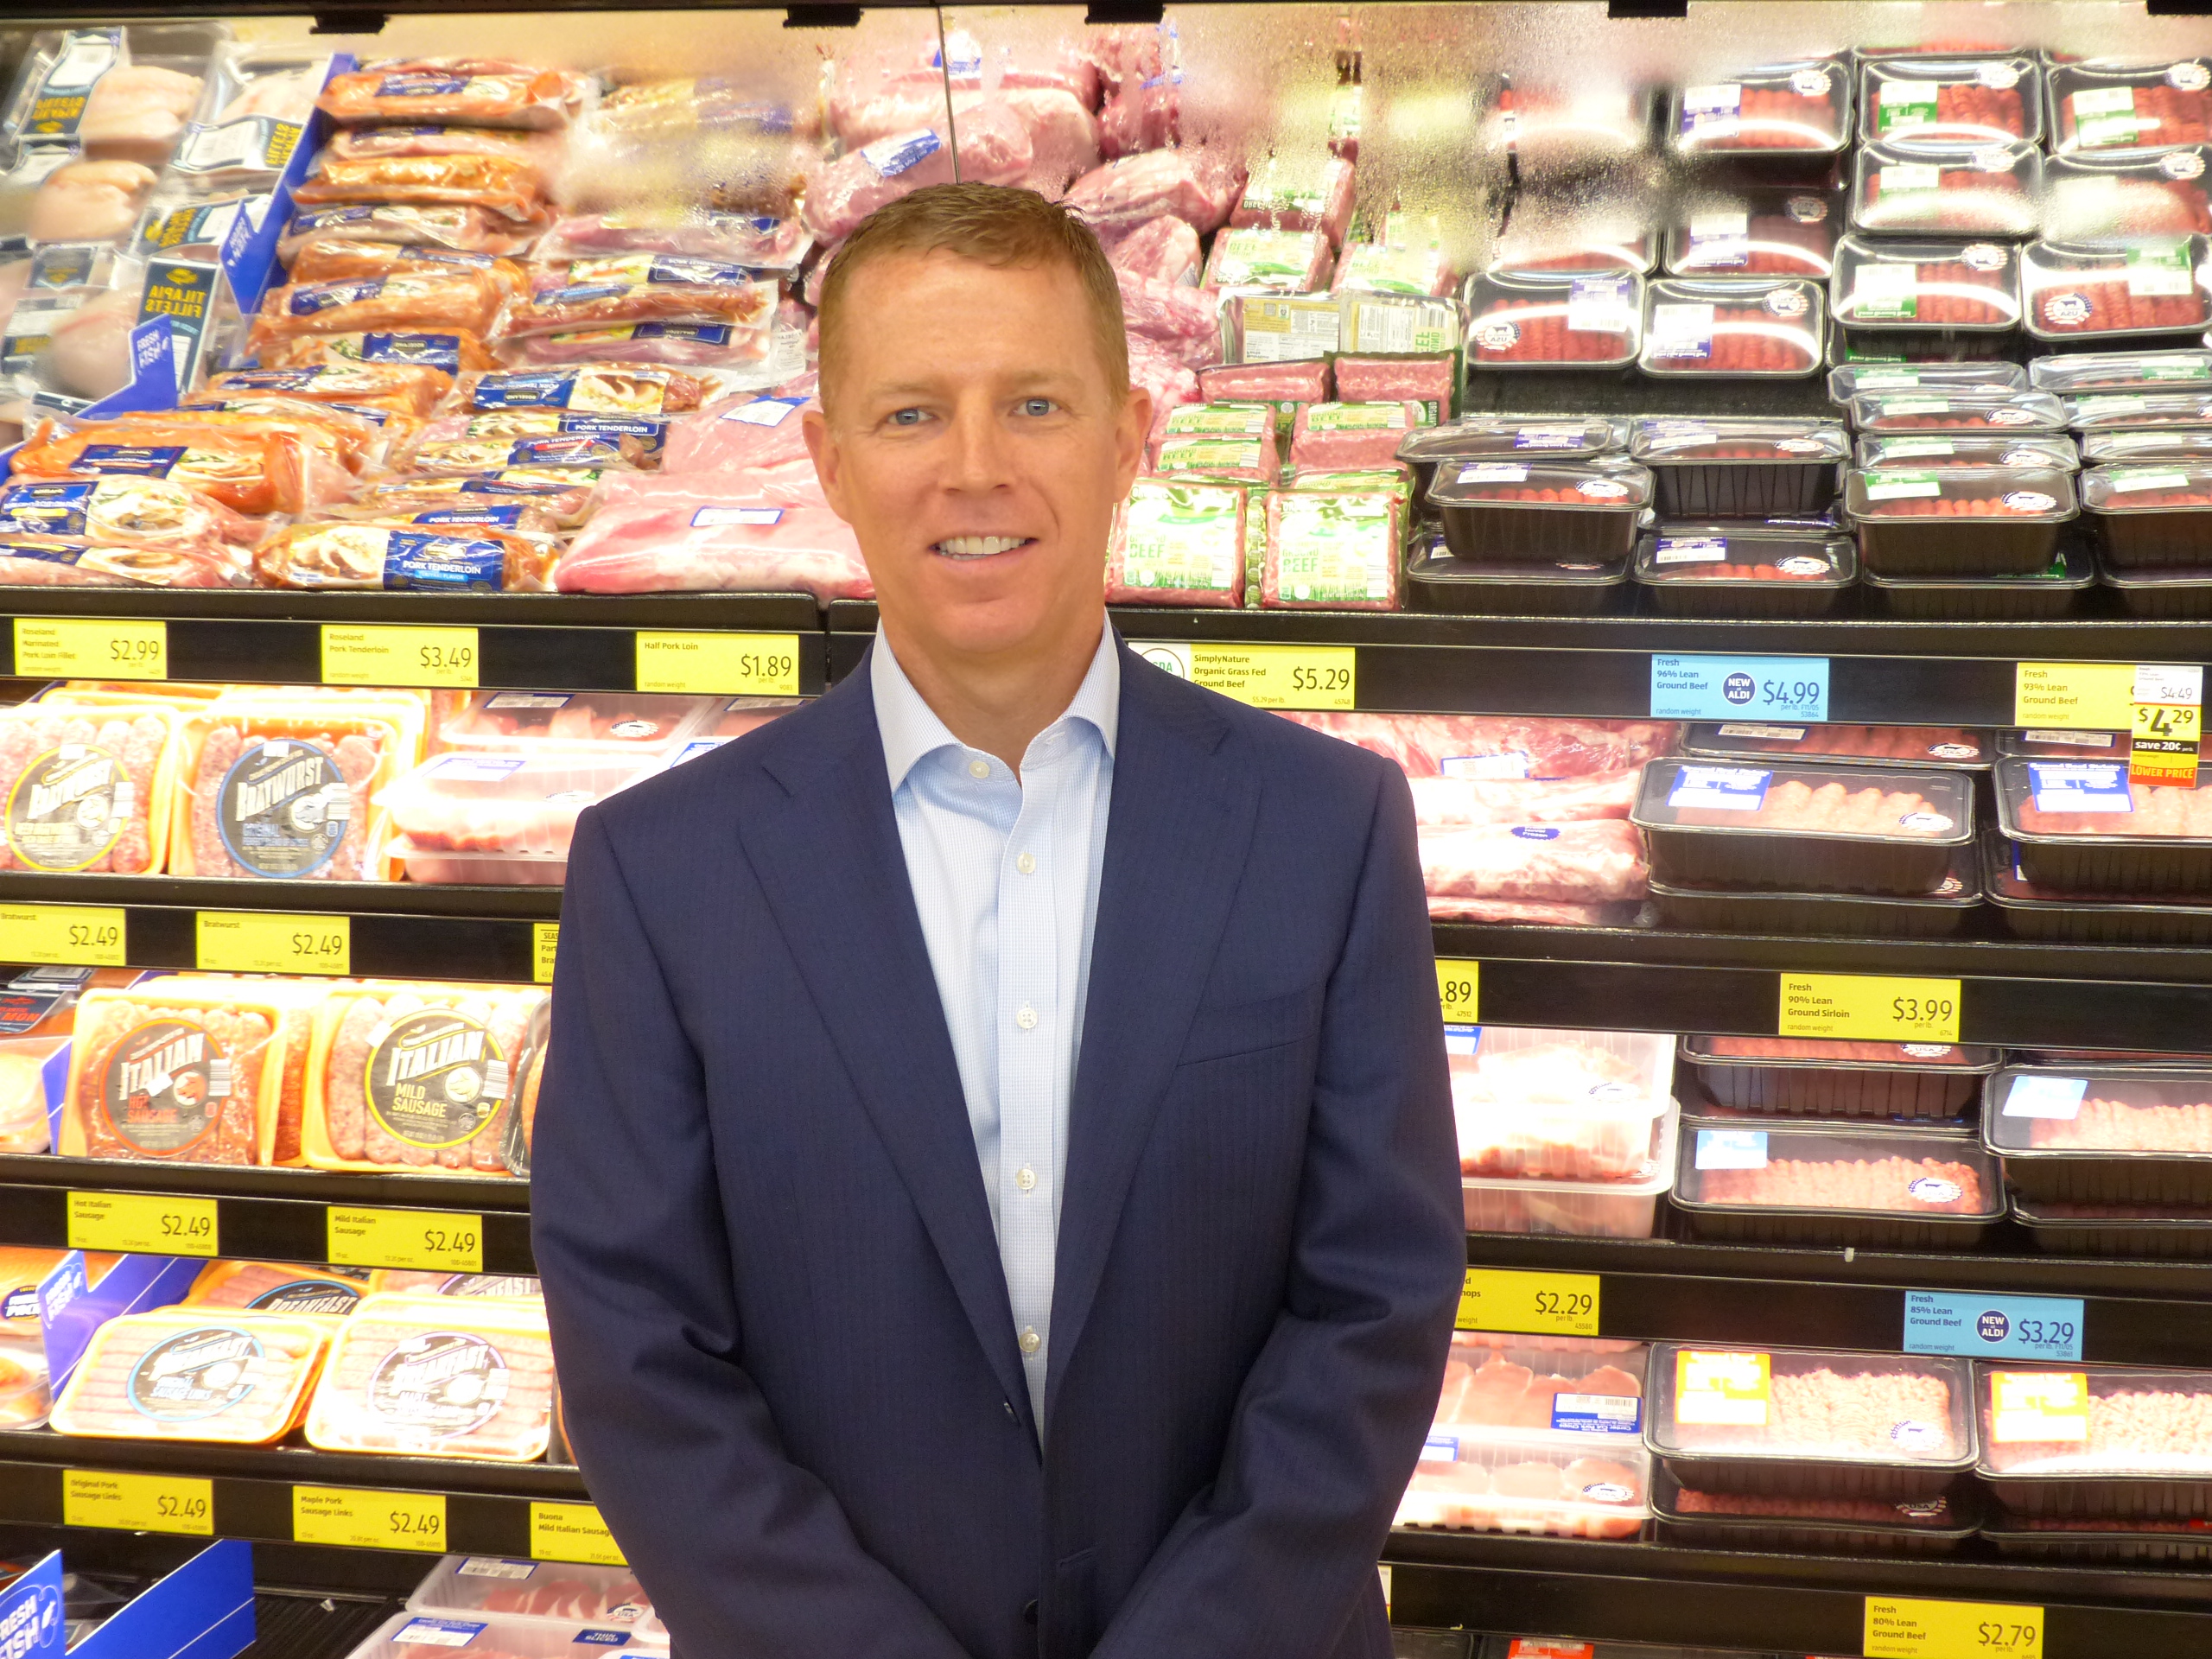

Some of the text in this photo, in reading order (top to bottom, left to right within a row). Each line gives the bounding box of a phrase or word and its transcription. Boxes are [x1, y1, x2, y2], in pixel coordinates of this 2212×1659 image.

[1129, 544, 1164, 558] BEEF
[1282, 549, 1318, 557] GROUND
[403, 561, 481, 574] PORK TENDERLOIN
[1282, 558, 1318, 572] BEEF
[110, 639, 158, 661] $2.99
[421, 645, 471, 668] $3.49
[741, 653, 791, 677] $1.89
[1194, 667, 1225, 676] Organic
[1293, 666, 1350, 690] $5.29
[1728, 690, 1750, 699] ALDI
[1763, 680, 1820, 705] $4.99
[2161, 686, 2193, 699] $4.49
[2162, 742, 2181, 751] 20¢
[2132, 766, 2162, 777] LOWER
[2166, 769, 2193, 778] PRICE
[236, 757, 323, 821] BRATWURST
[69, 924, 118, 947] $2.49
[293, 933, 342, 956] $2.49
[1440, 982, 1471, 1002] .89
[1789, 1008, 1850, 1018] Ground Sirloin
[1893, 997, 1952, 1021] $3.99
[119, 1033, 204, 1100] ITALIAN
[386, 1031, 484, 1086] ITALIAN
[396, 1084, 426, 1099] MILD
[127, 1109, 177, 1123] SAUSAGE
[392, 1098, 447, 1117] SAUSAGE
[74, 1211, 105, 1220] Sausage
[162, 1214, 210, 1236] $2.49
[335, 1227, 365, 1236] Sausage
[425, 1229, 475, 1252] $2.49
[1535, 1291, 1592, 1315] $2.29
[1982, 1328, 2004, 1337] ALDI
[2018, 1319, 2074, 1344] $3.29
[71, 1491, 100, 1500] Sausage
[157, 1495, 206, 1518] $2.49
[301, 1508, 332, 1516] Sausage
[390, 1511, 439, 1534] $2.49
[582, 1528, 612, 1536] Sausag
[0, 1594, 37, 1641] RESH
[1979, 1622, 2036, 1646] $2.79
